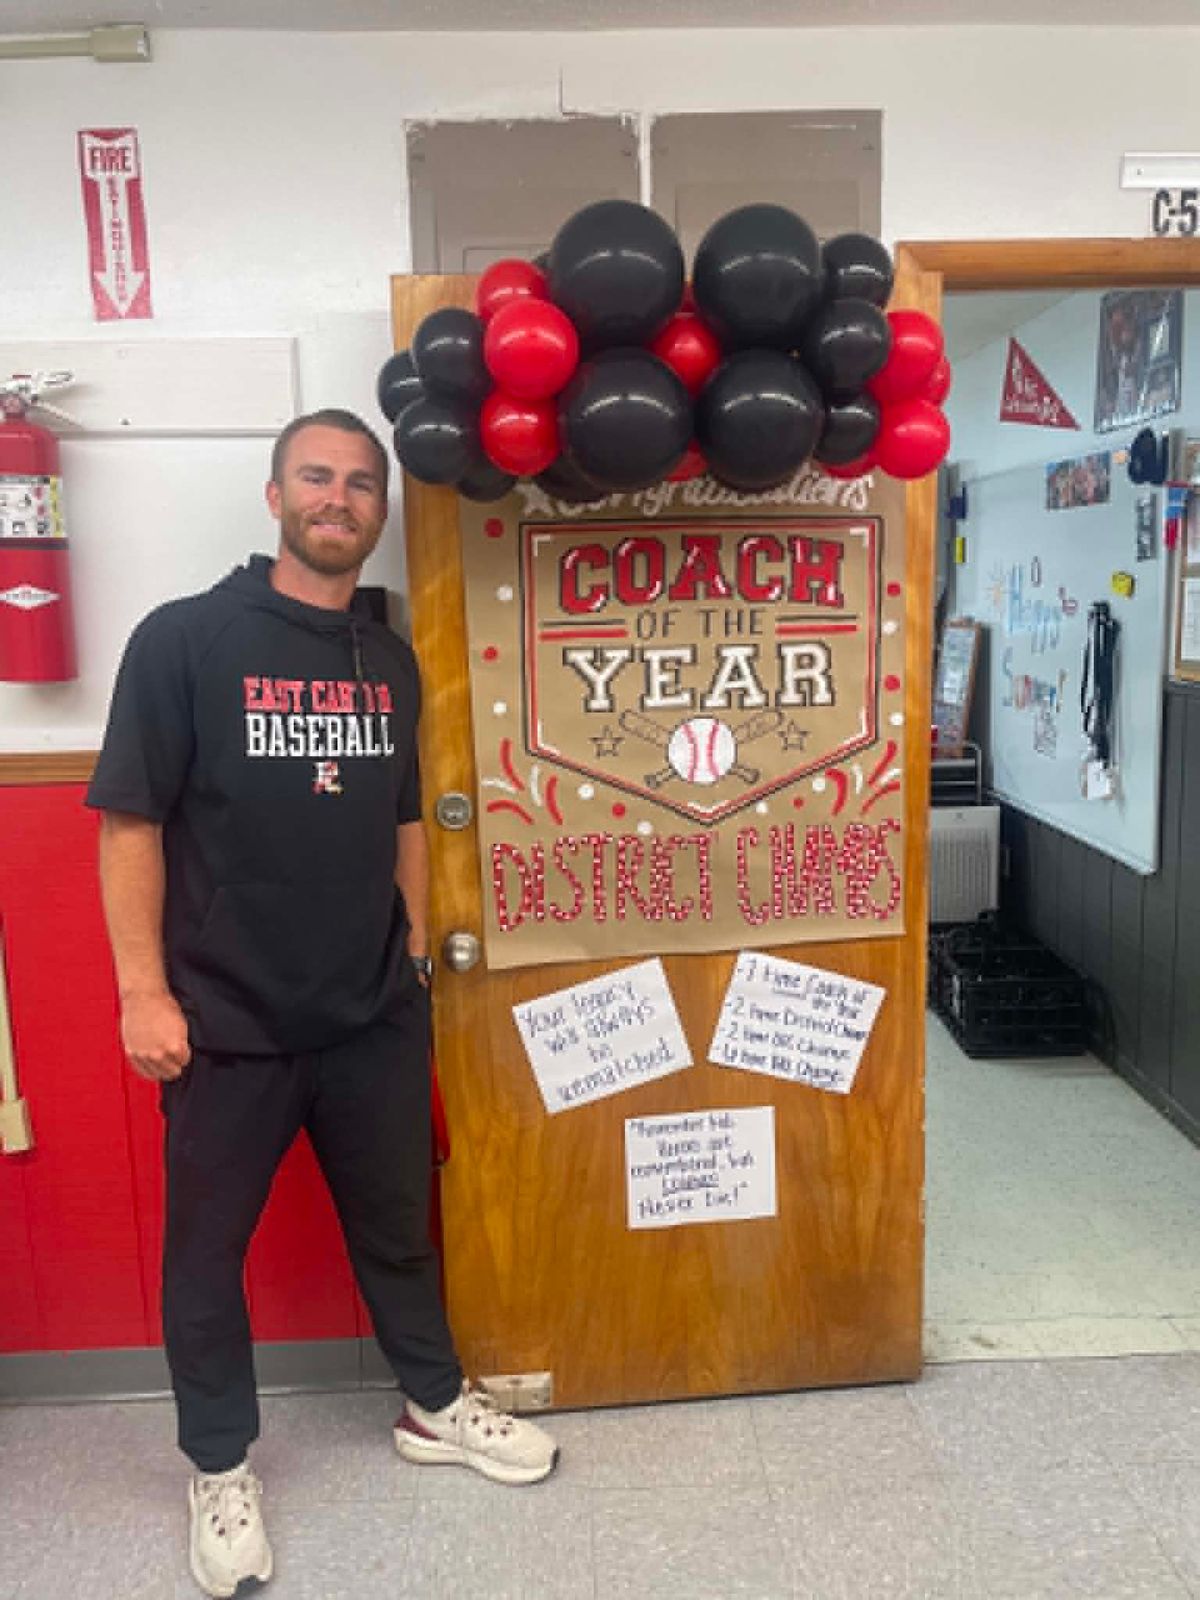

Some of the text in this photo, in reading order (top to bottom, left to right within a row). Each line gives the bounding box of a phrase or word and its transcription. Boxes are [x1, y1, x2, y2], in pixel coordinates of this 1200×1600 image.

[90, 147, 132, 172] FIRE
[1153, 188, 1197, 237] C-5
[559, 535, 844, 615] COACH
[637, 607, 766, 640] OF THE
[244, 676, 304, 713] EAST
[562, 640, 836, 712] YEAR
[245, 713, 395, 757] BASEBALL
[492, 818, 902, 932] DISTRICT CHAMPS
